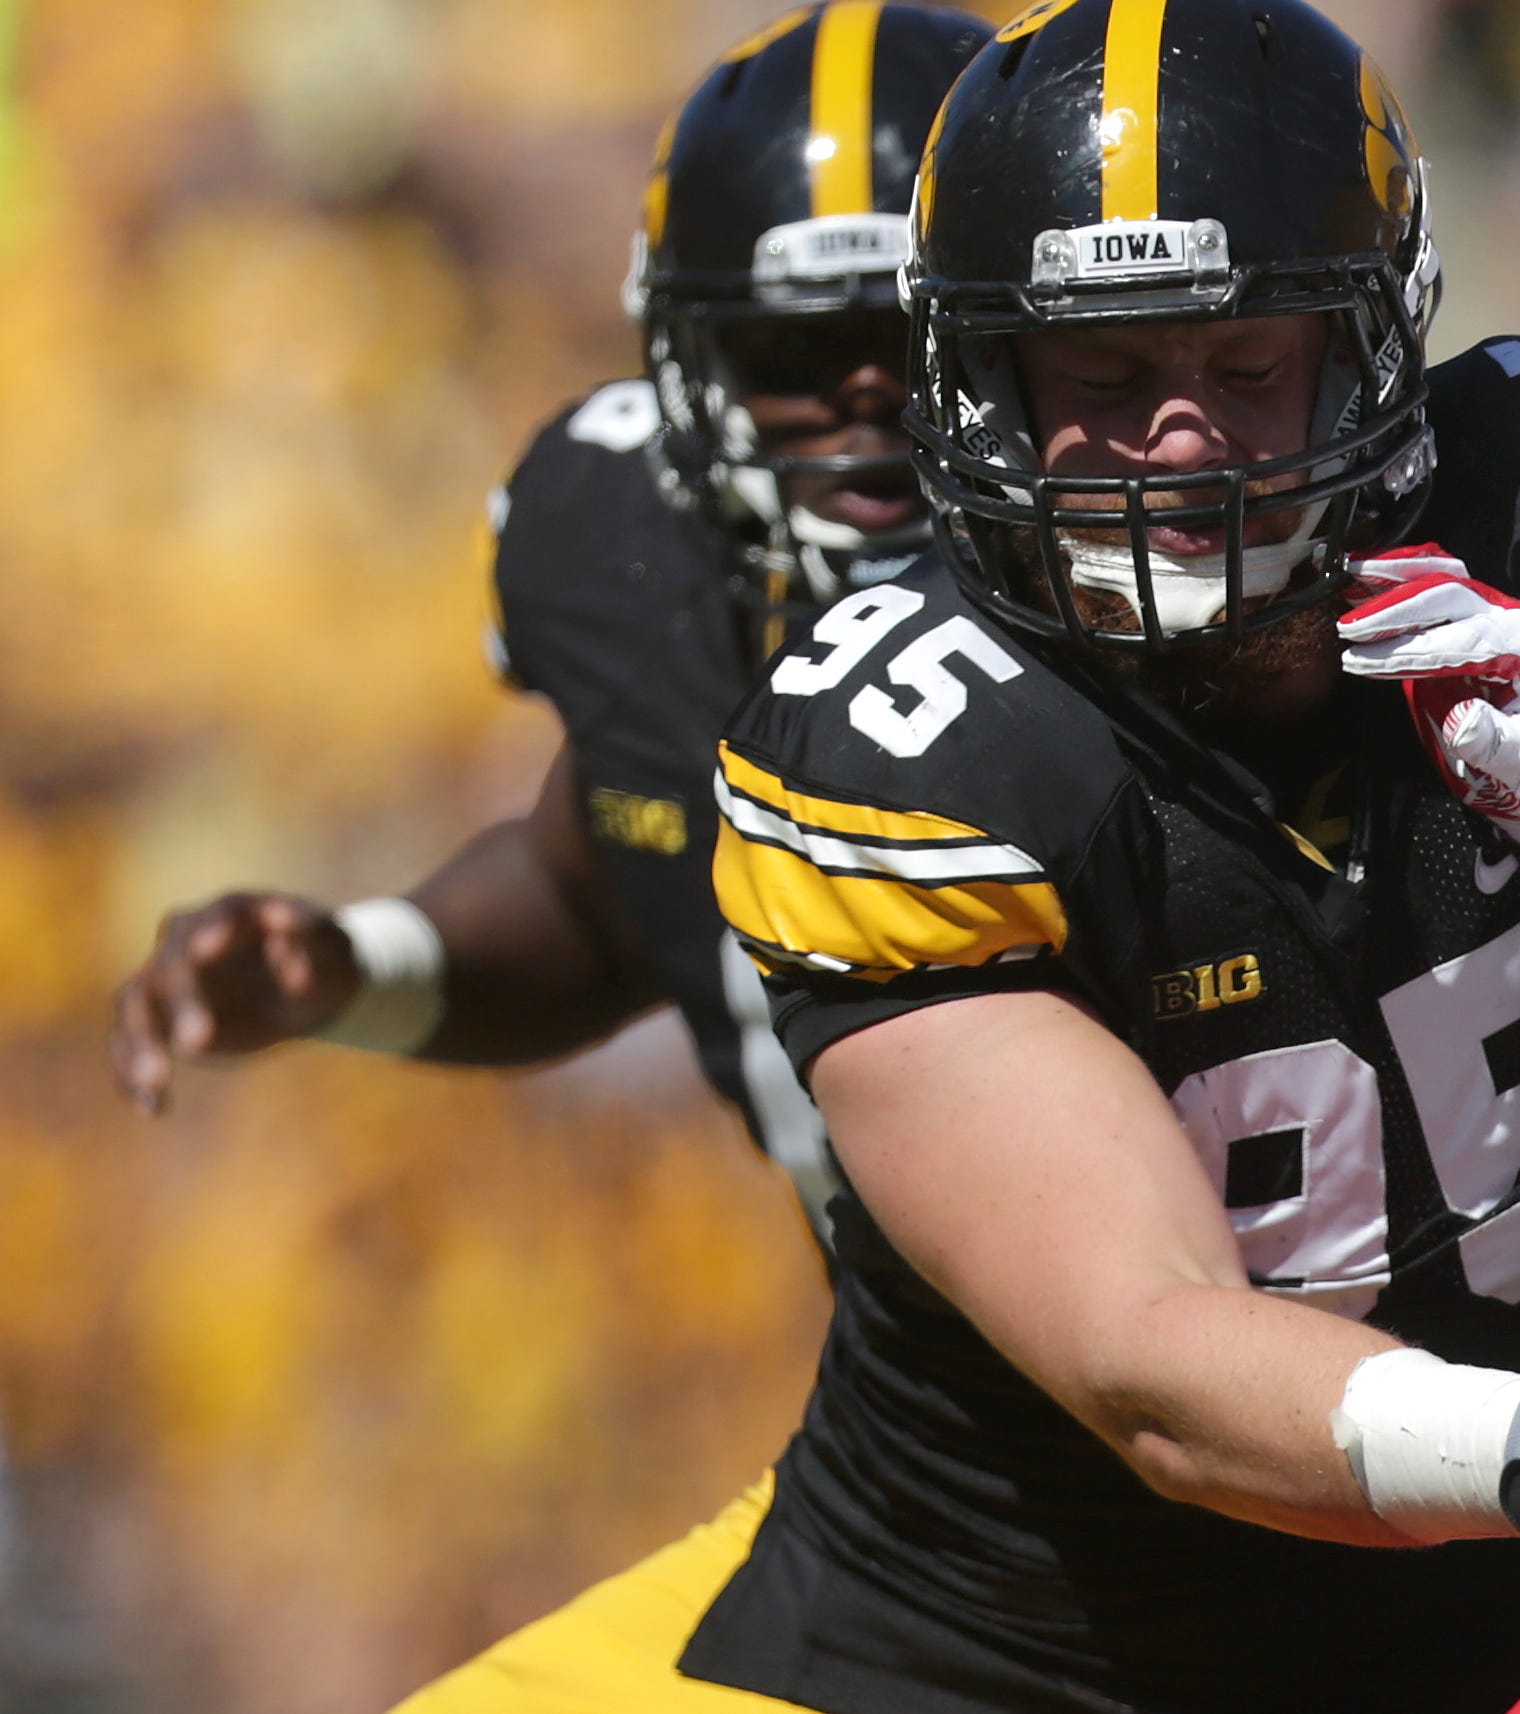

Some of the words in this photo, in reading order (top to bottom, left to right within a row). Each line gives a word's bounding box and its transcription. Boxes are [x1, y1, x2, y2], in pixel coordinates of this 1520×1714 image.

[1093, 232, 1172, 263] IOWA
[770, 584, 1025, 758] 95
[1152, 953, 1261, 1021] BIG
